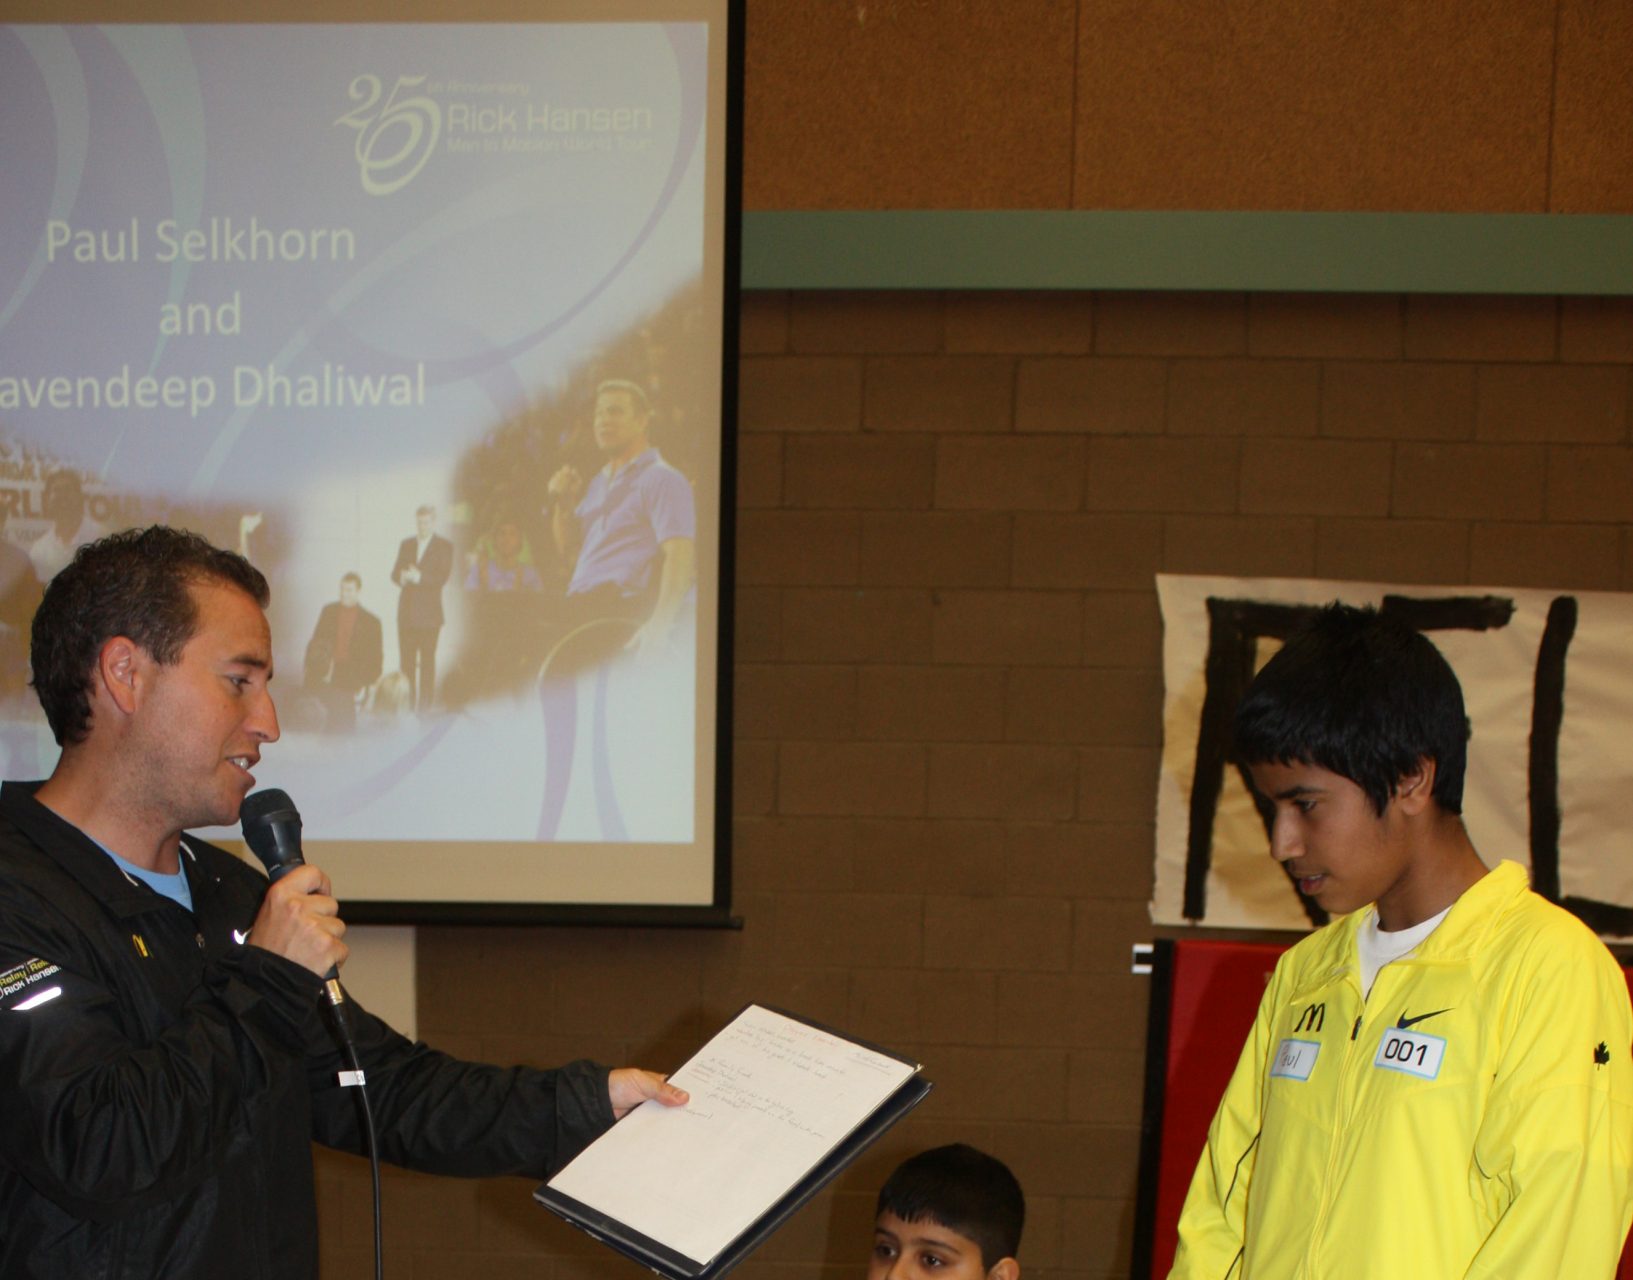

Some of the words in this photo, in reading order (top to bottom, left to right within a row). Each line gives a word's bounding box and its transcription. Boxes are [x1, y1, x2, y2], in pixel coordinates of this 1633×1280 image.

[448, 103, 518, 133] Rick
[527, 103, 653, 133] Hansen
[46, 218, 139, 263] Paul
[155, 216, 356, 263] Selkhorn
[159, 290, 242, 336] and
[233, 362, 426, 407] Dhaliwal
[1384, 1037, 1429, 1067] 001
